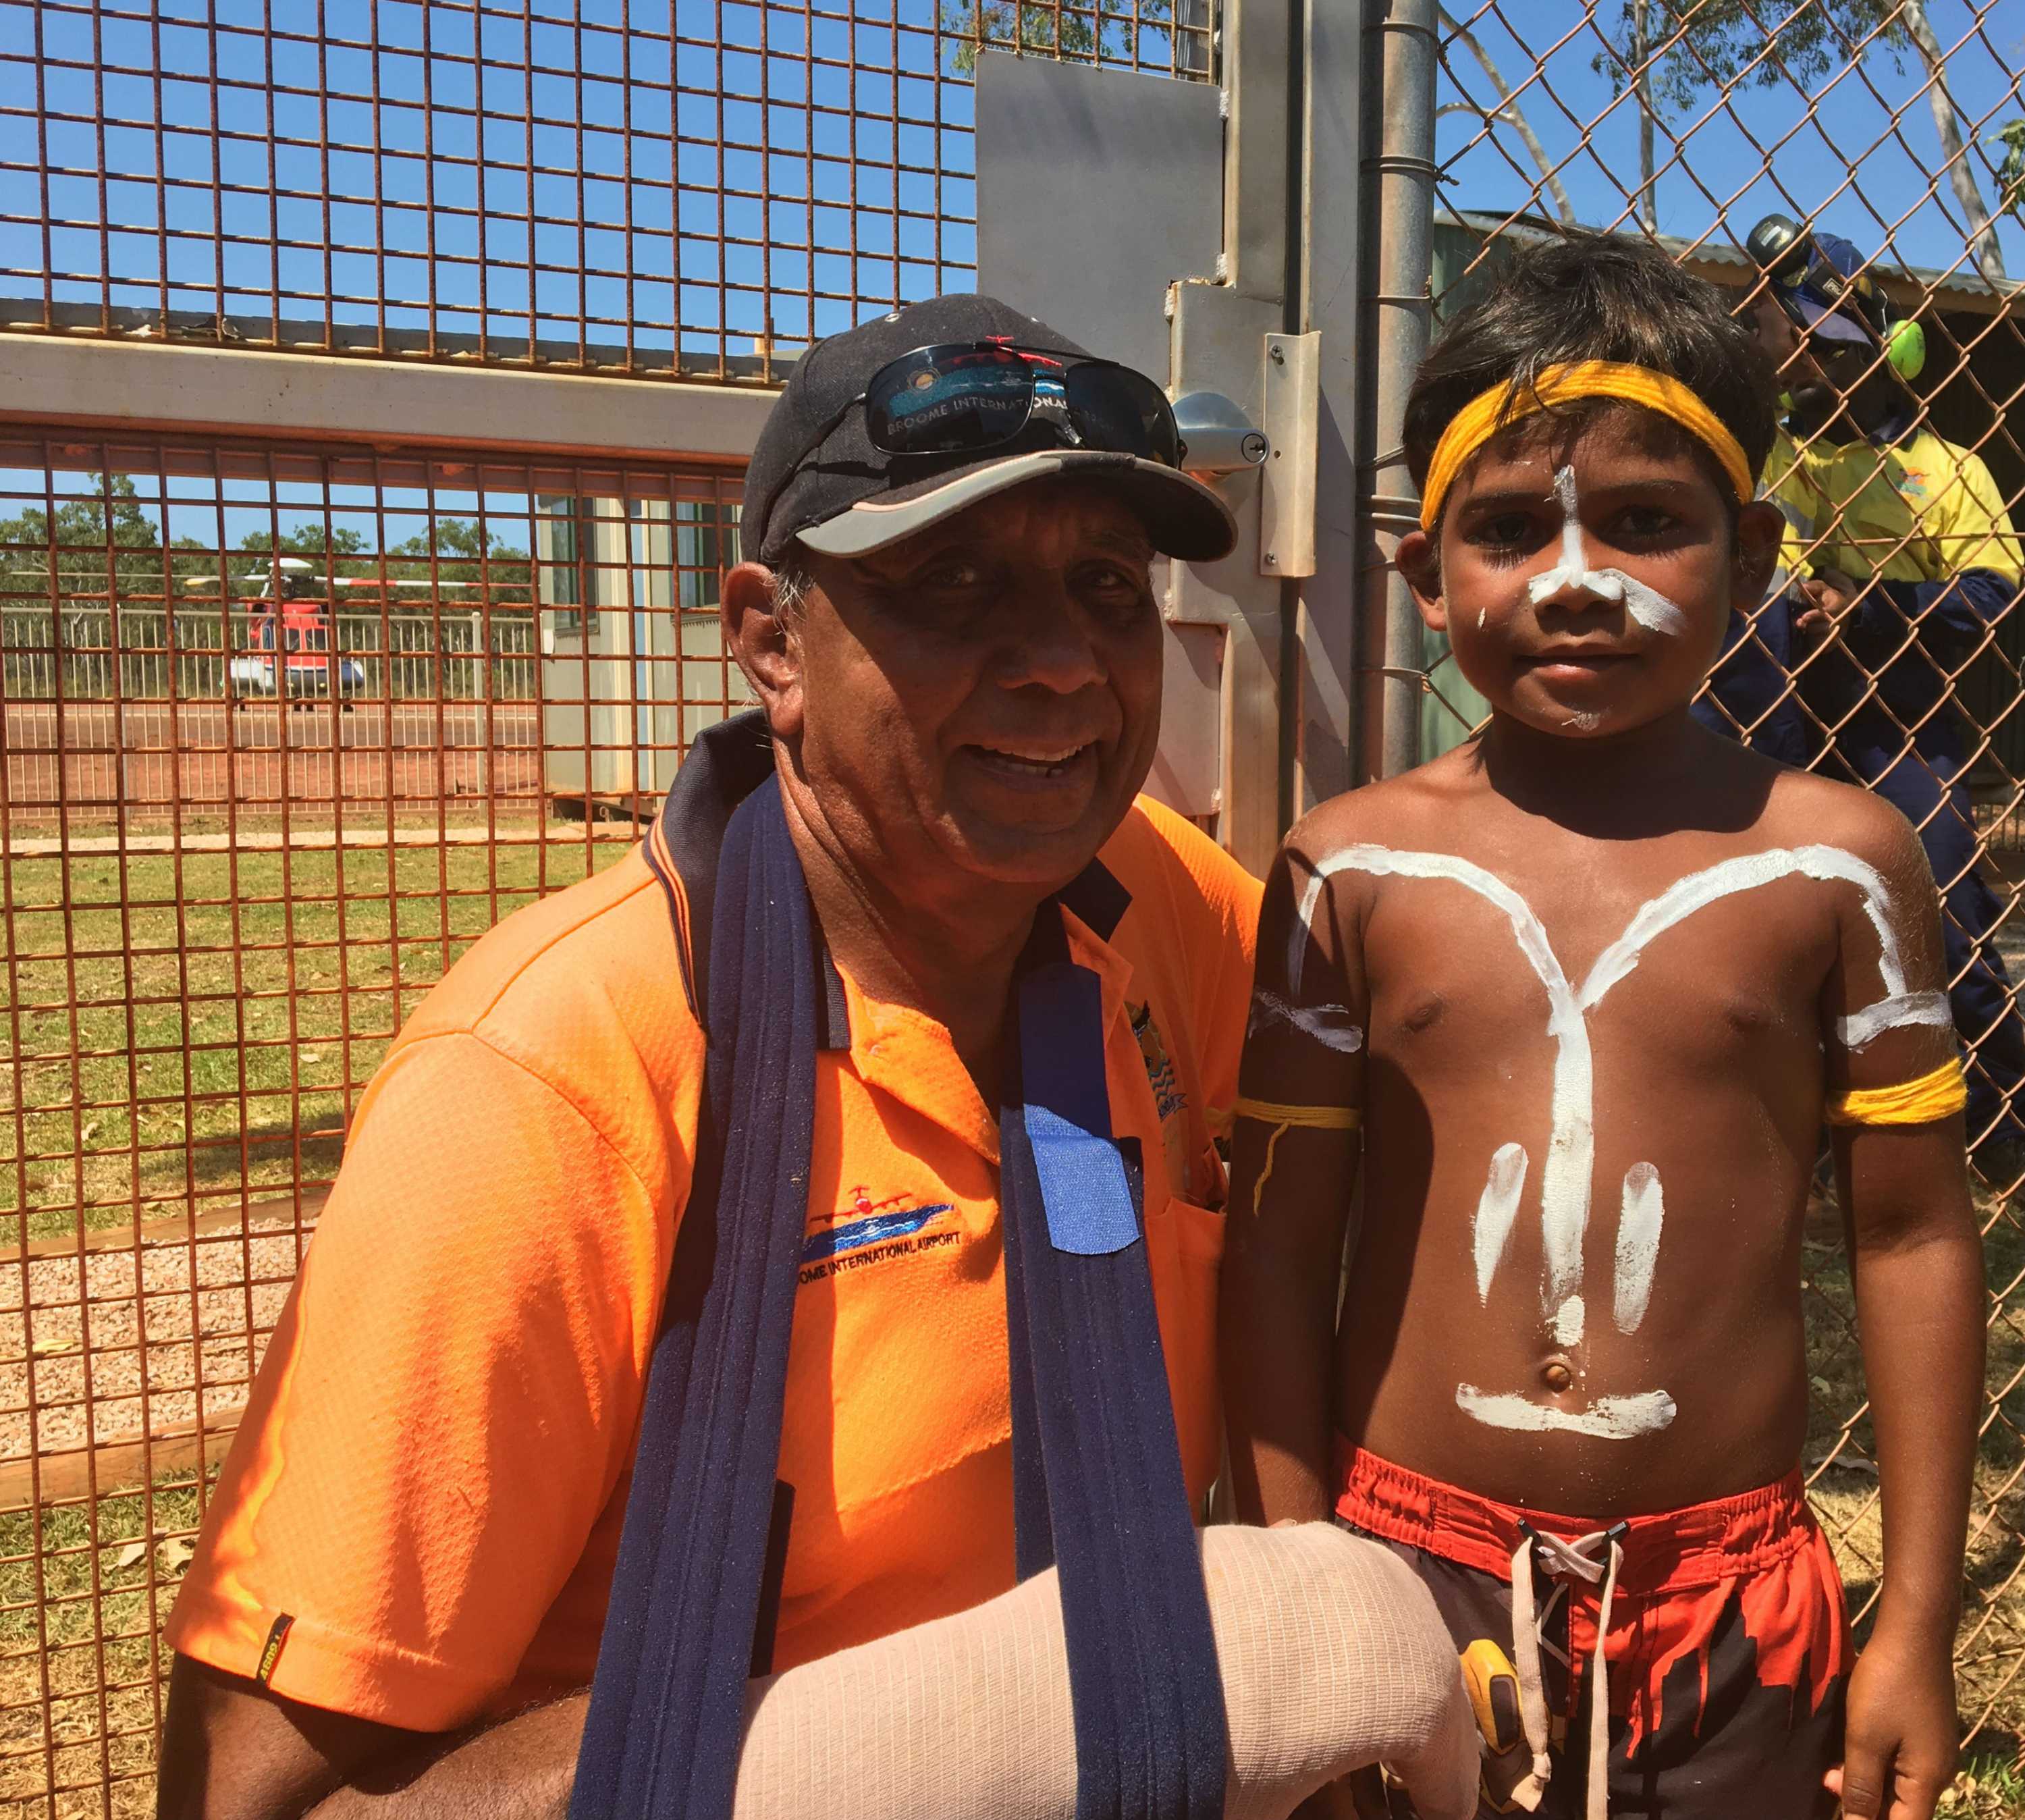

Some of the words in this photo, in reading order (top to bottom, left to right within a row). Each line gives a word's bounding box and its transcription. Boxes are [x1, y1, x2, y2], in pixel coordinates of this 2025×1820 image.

[887, 404, 949, 435] BROOME
[828, 1239, 917, 1276] INTERNATIONAL
[917, 1231, 962, 1250] AIRPORT
